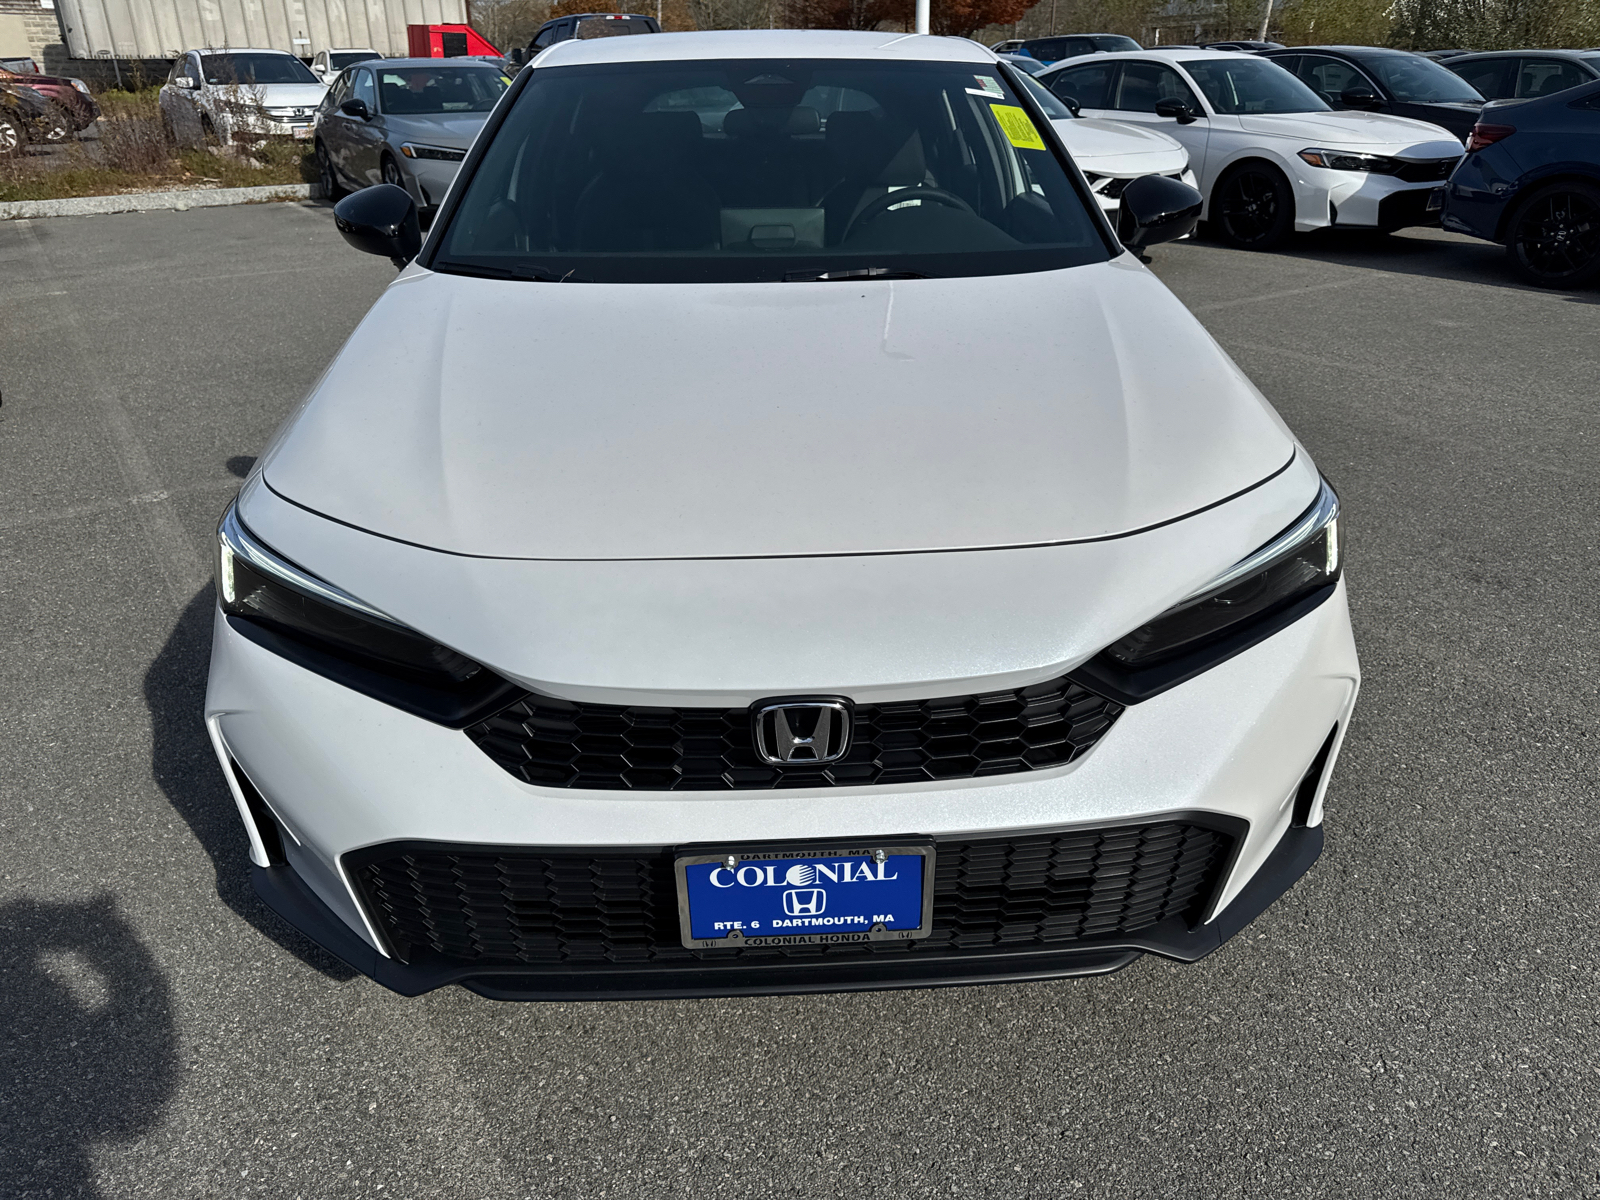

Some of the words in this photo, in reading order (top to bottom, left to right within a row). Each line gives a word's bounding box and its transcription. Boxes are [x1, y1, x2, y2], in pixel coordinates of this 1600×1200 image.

[709, 860, 898, 888] COLONIAL
[714, 921, 747, 930] RTE.
[750, 920, 760, 929] 6
[772, 916, 869, 928] DARTMOUTH,
[872, 914, 895, 923] MA
[744, 935, 816, 946] COLONIAL
[819, 933, 871, 943] HONDA
